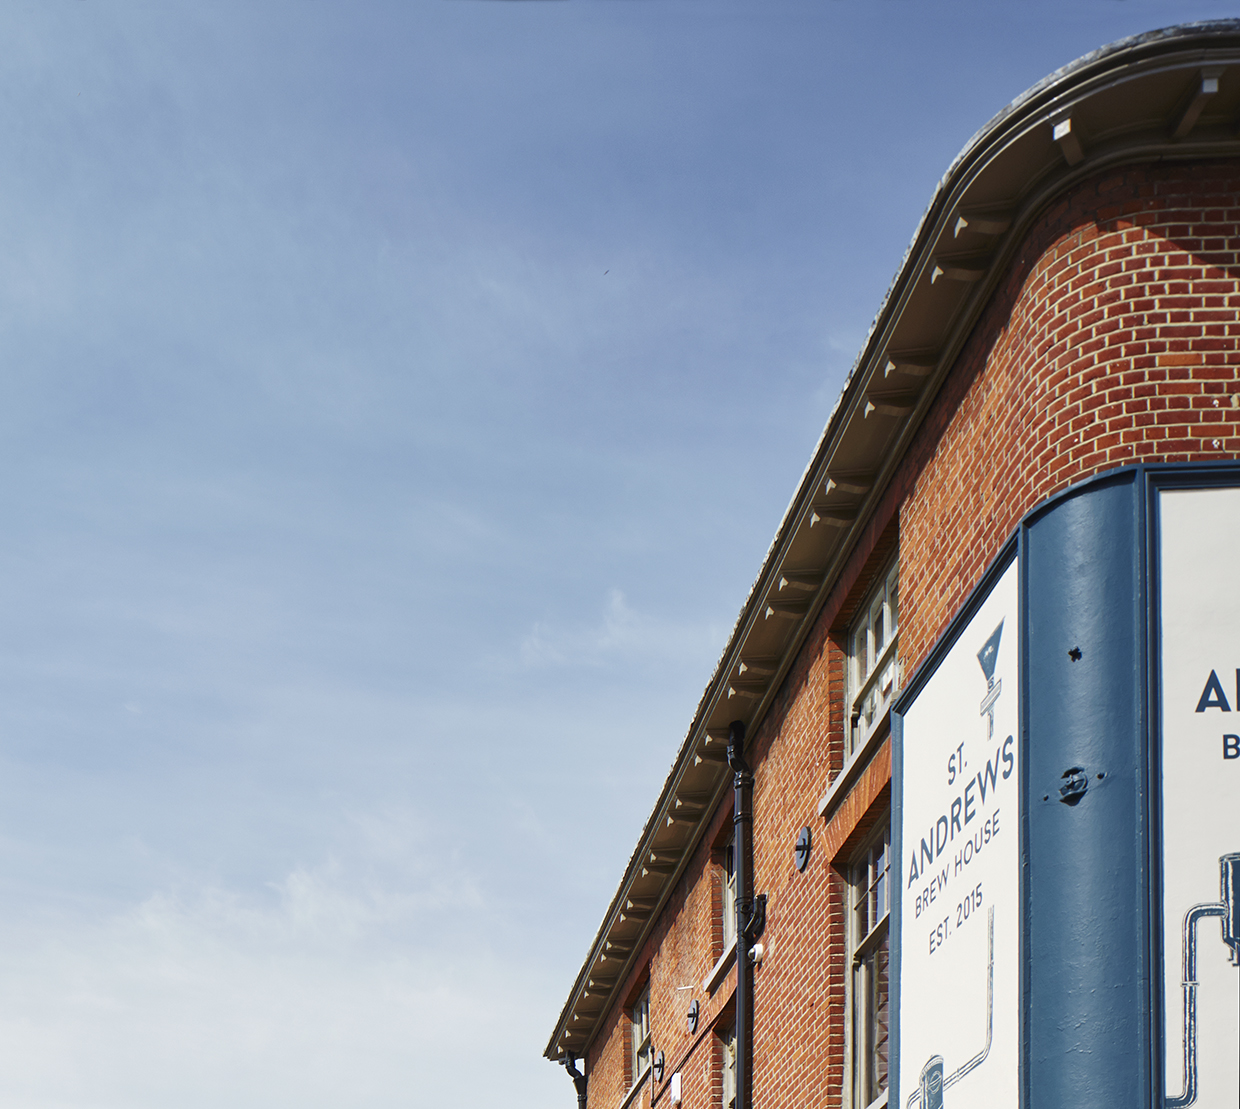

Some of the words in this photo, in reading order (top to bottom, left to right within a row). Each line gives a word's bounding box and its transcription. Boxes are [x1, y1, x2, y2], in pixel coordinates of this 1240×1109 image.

[948, 741, 968, 786] ST.
[908, 735, 1014, 890] ANDREWS
[916, 864, 950, 919] BREW
[955, 809, 1000, 877] HOUSE
[929, 916, 952, 955] EST.
[957, 882, 983, 928] 2015
